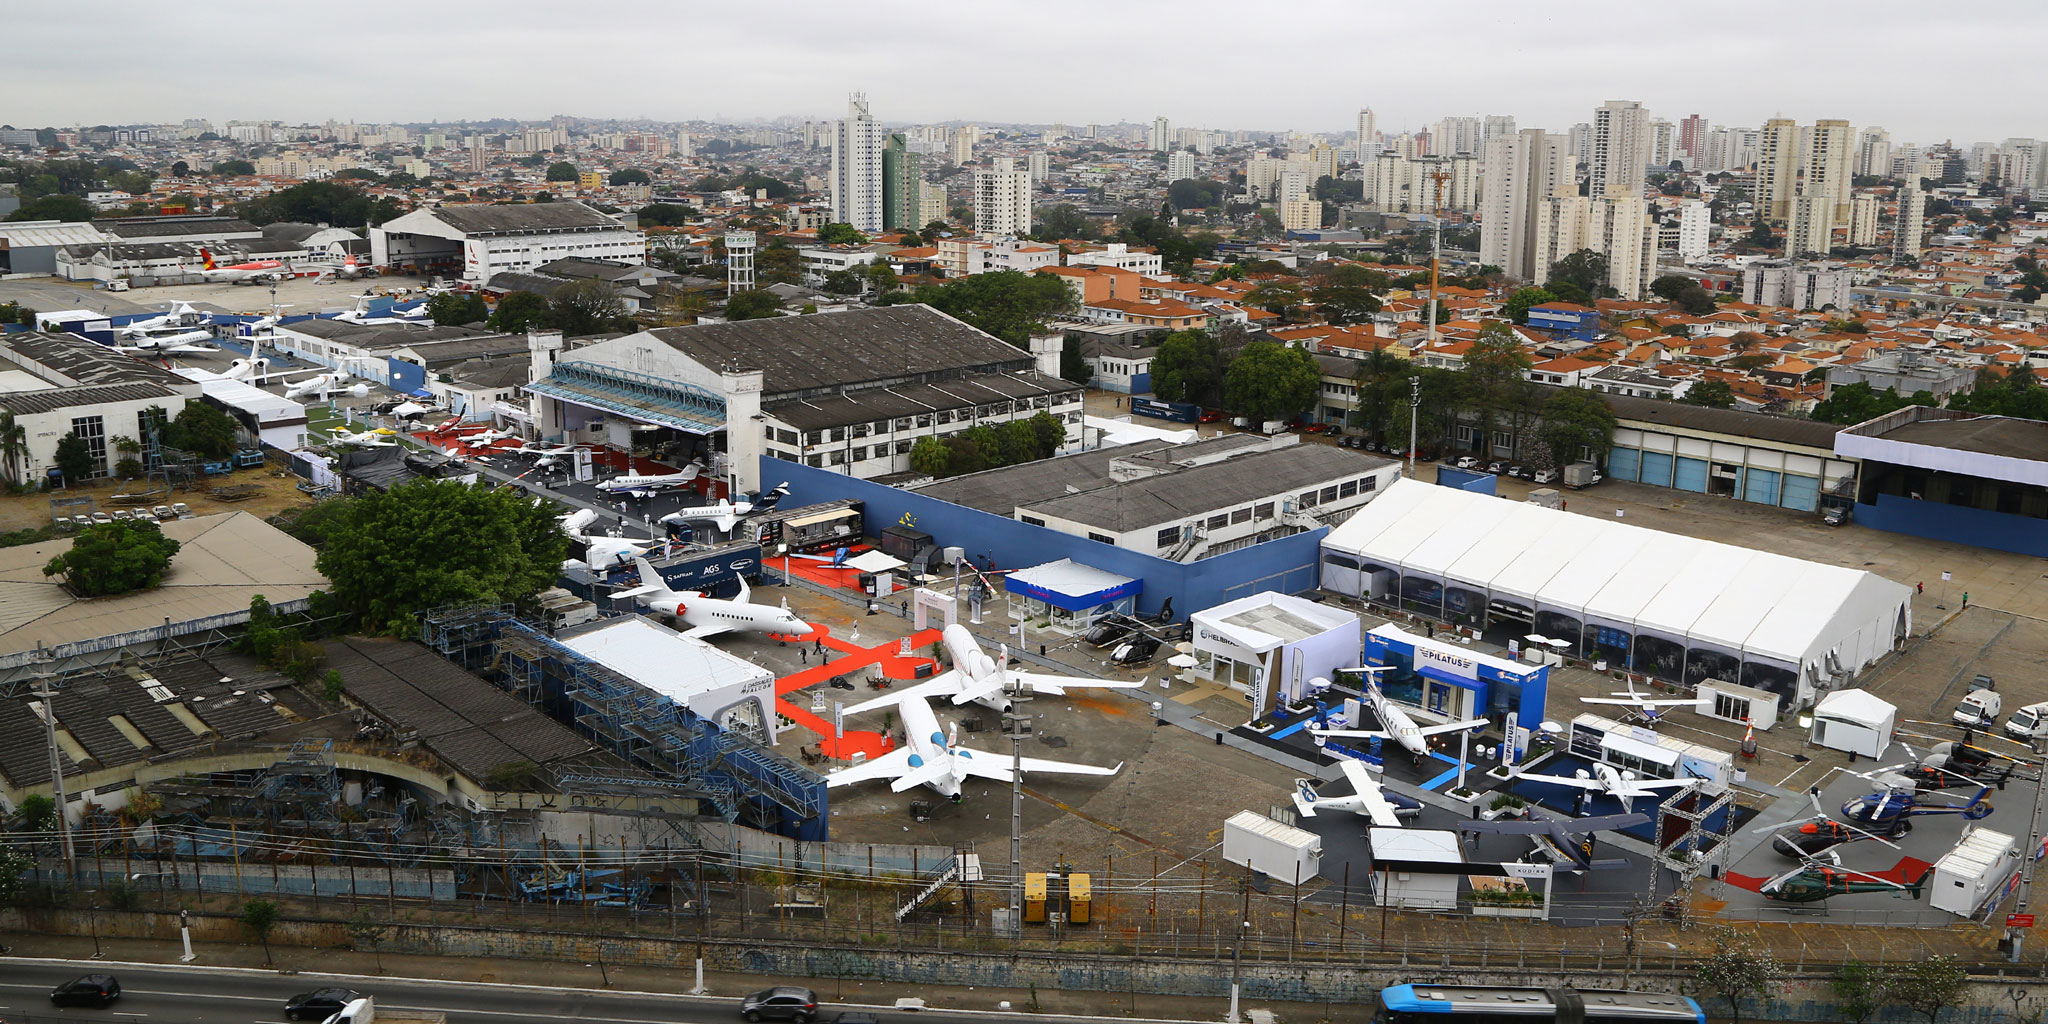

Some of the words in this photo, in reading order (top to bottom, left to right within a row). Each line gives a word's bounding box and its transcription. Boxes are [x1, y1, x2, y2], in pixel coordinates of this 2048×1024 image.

[672, 571, 694, 581] SAFRAN
[703, 563, 720, 576] AGS
[1207, 633, 1240, 648] HELIBR
[1429, 651, 1463, 667] PILATUS
[746, 682, 771, 694] FALCON
[1506, 725, 1515, 754] PILATUS
